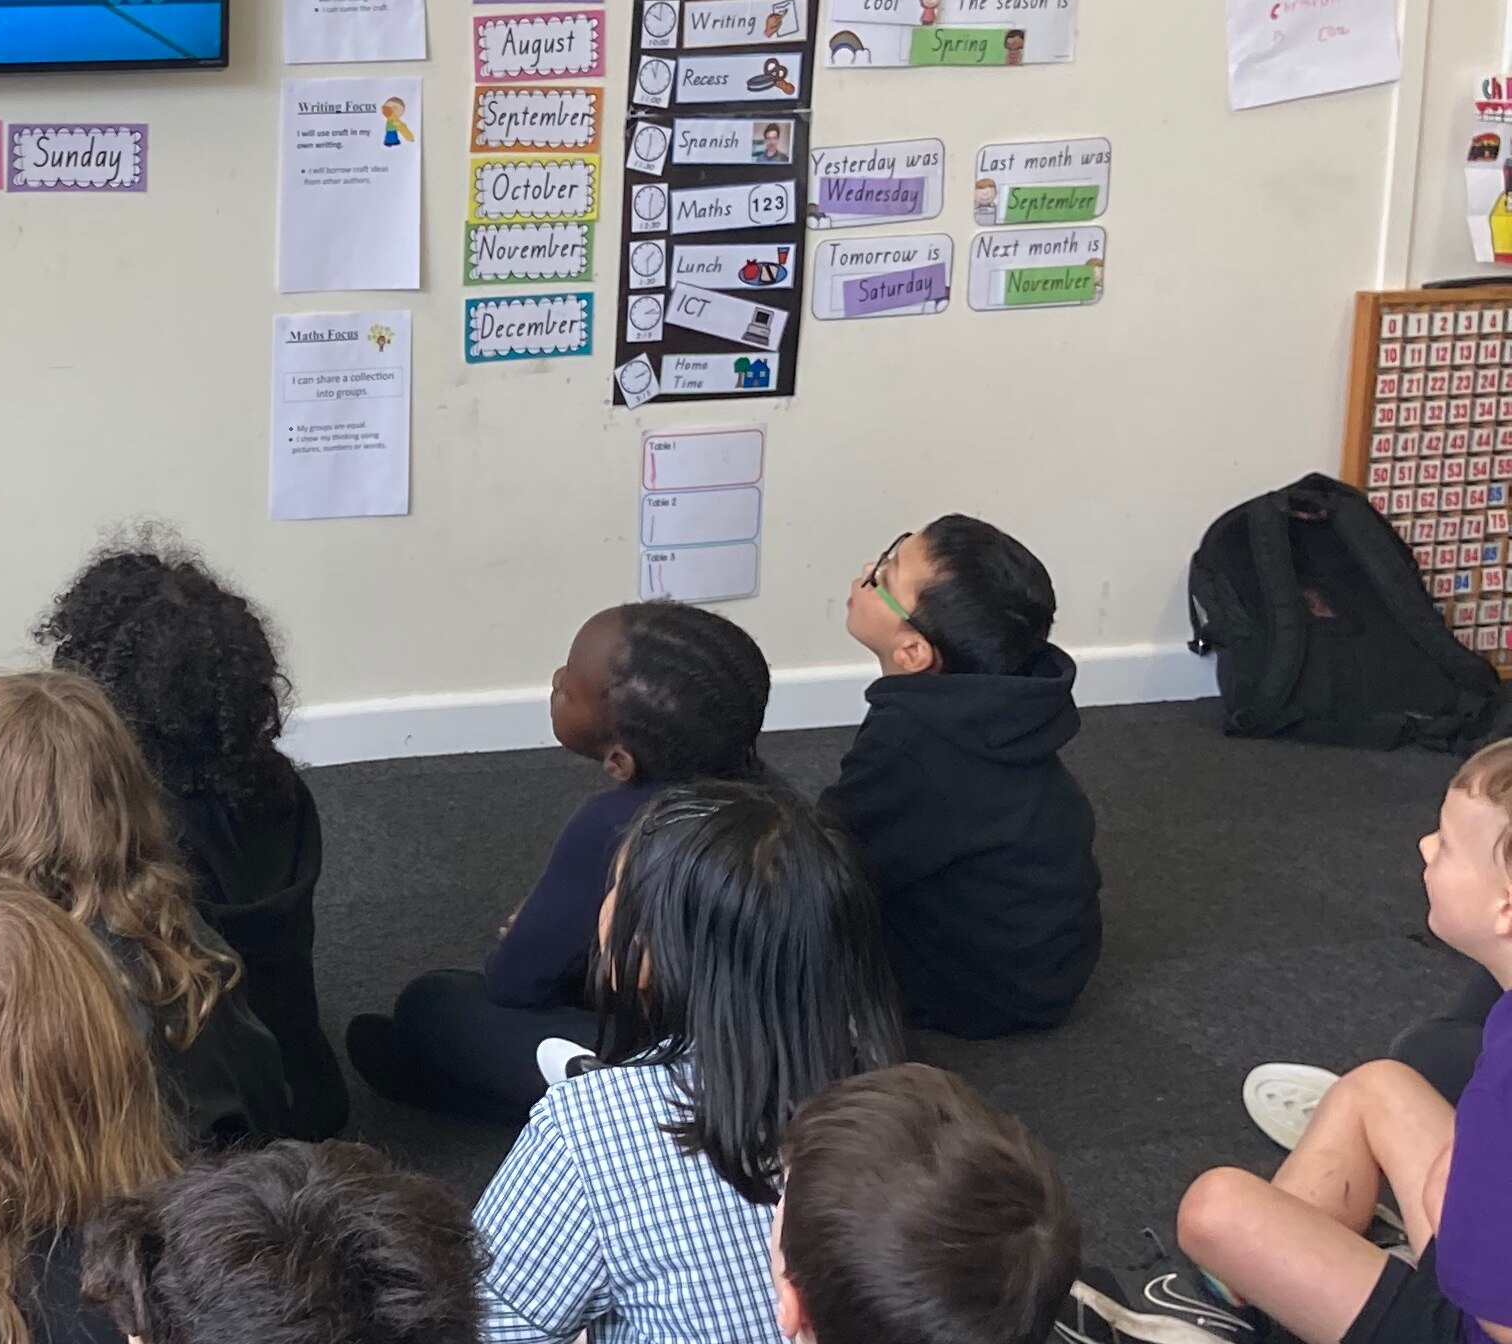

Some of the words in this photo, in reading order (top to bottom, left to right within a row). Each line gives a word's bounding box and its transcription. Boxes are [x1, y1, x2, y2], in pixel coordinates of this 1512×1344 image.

[691, 12, 756, 35] Writing
[502, 27, 576, 67] August
[932, 29, 988, 62] Spring
[683, 69, 729, 86] Recess
[298, 102, 341, 114] Writing
[346, 102, 376, 112] Focus
[485, 100, 589, 139] September
[678, 130, 739, 154] Spanish
[33, 135, 122, 182] Sunday
[811, 149, 895, 179] Yesterday
[906, 151, 939, 167] was
[980, 150, 1016, 173] Last
[1024, 145, 1072, 168] month
[1080, 150, 1111, 166] was
[492, 171, 578, 201] October
[827, 181, 921, 212] Wednesday
[678, 200, 732, 220] Maths
[1009, 188, 1095, 220] September
[478, 232, 580, 261] November
[829, 243, 918, 267] Tomorrow
[927, 244, 940, 261] is
[976, 236, 1020, 259] Next
[1028, 231, 1078, 256] month
[1087, 237, 1100, 253] is
[676, 257, 722, 274] Lunch
[858, 271, 933, 302] Saturday
[1007, 268, 1091, 293] November
[676, 294, 711, 318] ICT
[290, 330, 324, 341] Maths
[328, 329, 359, 340] Focus
[480, 309, 578, 341] December
[1389, 319, 1396, 334] 0
[1417, 318, 1421, 333] 1
[1440, 316, 1448, 331] 2
[1465, 316, 1472, 330] 3
[1490, 314, 1497, 329] 4
[674, 359, 708, 372] Home
[1384, 348, 1397, 363] 10
[1411, 348, 1422, 363] 11
[1436, 347, 1448, 362] 12
[1459, 345, 1472, 360] 13
[1484, 344, 1497, 360] 14
[317, 375, 340, 384] share
[350, 372, 394, 382] collection
[674, 376, 703, 389] Time
[1380, 379, 1395, 394] 20
[1407, 378, 1420, 393] 21
[1430, 377, 1446, 391] 22
[1456, 375, 1471, 390] 23
[1481, 373, 1496, 389] 24
[317, 389, 334, 398] into
[336, 388, 369, 399] groups.
